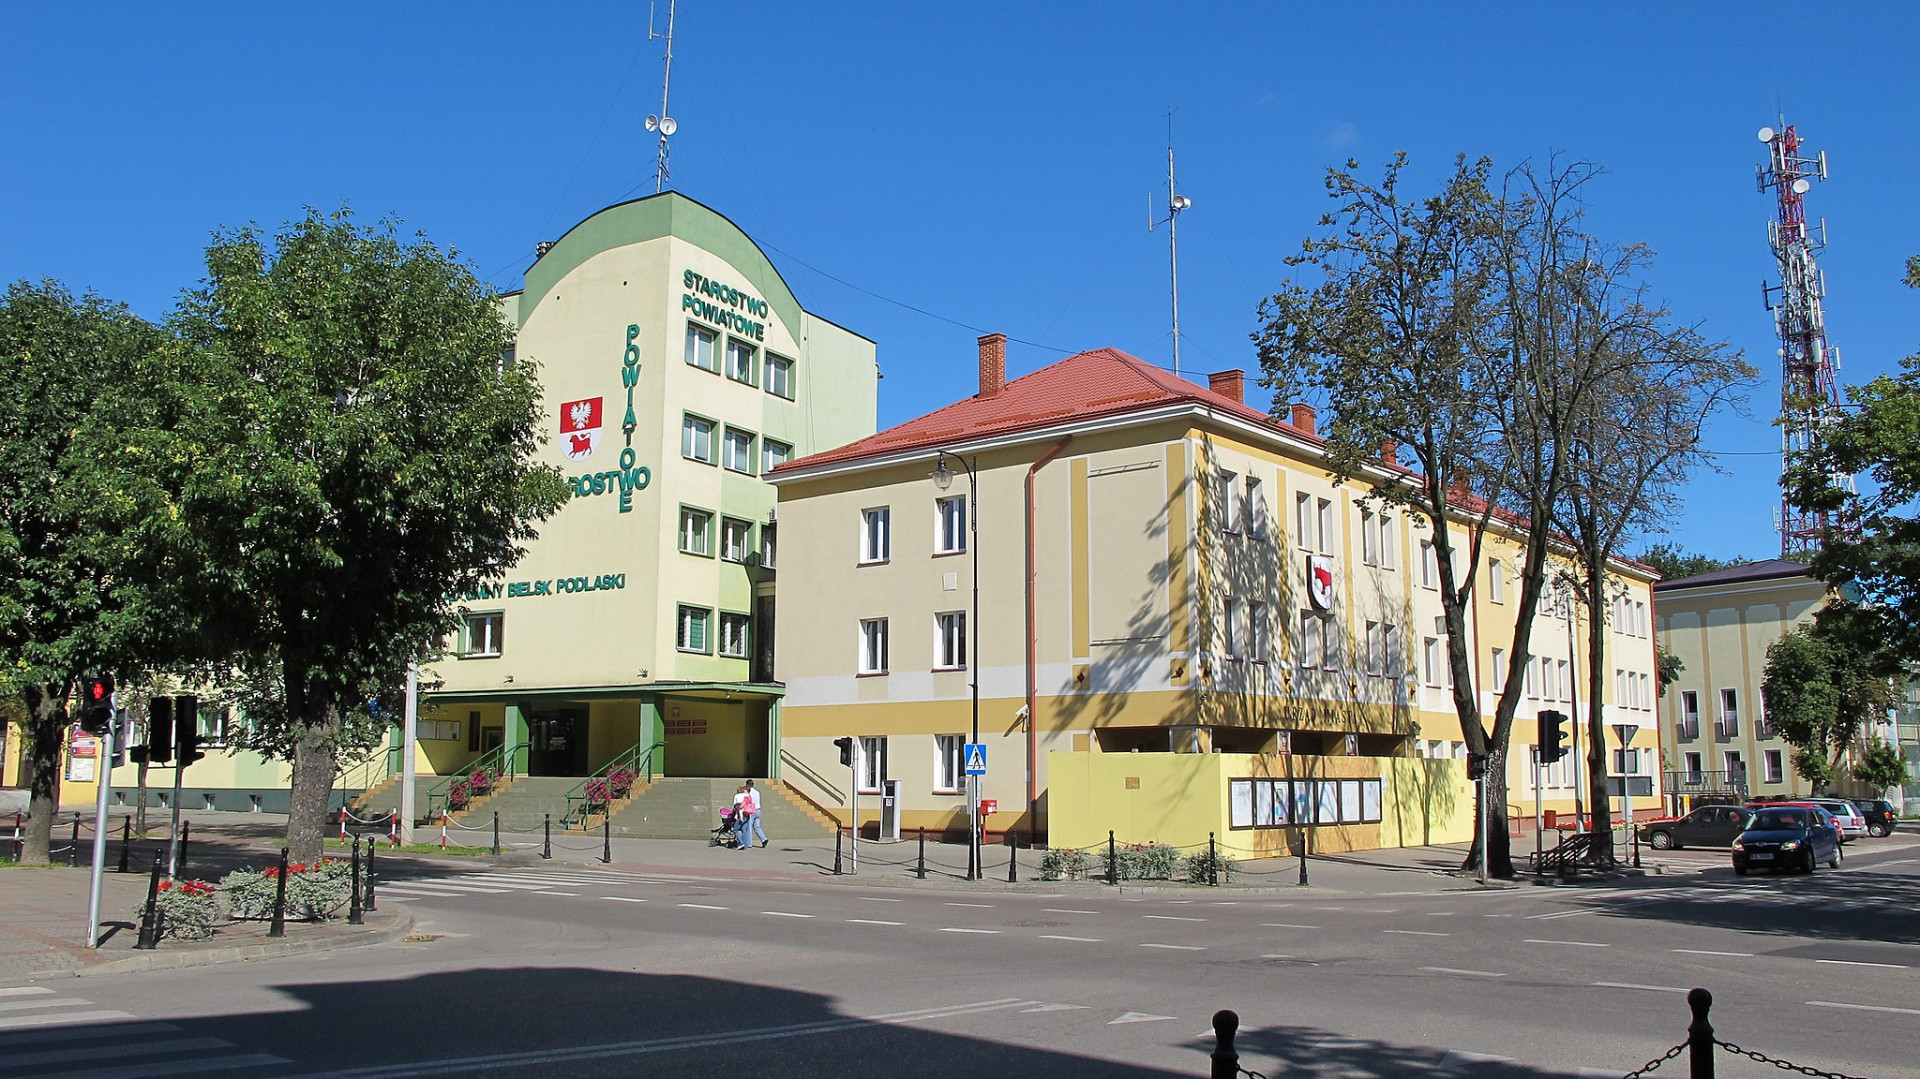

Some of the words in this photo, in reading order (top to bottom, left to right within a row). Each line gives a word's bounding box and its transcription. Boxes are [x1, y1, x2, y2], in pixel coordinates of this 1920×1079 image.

[682, 293, 765, 342] POWIATOWE
[683, 269, 768, 319] STAROSTWO
[619, 323, 642, 513] POWIATOWE
[567, 466, 651, 498] ROSTWO
[507, 580, 552, 598] BIELSK
[556, 573, 626, 594] PODLASKI
